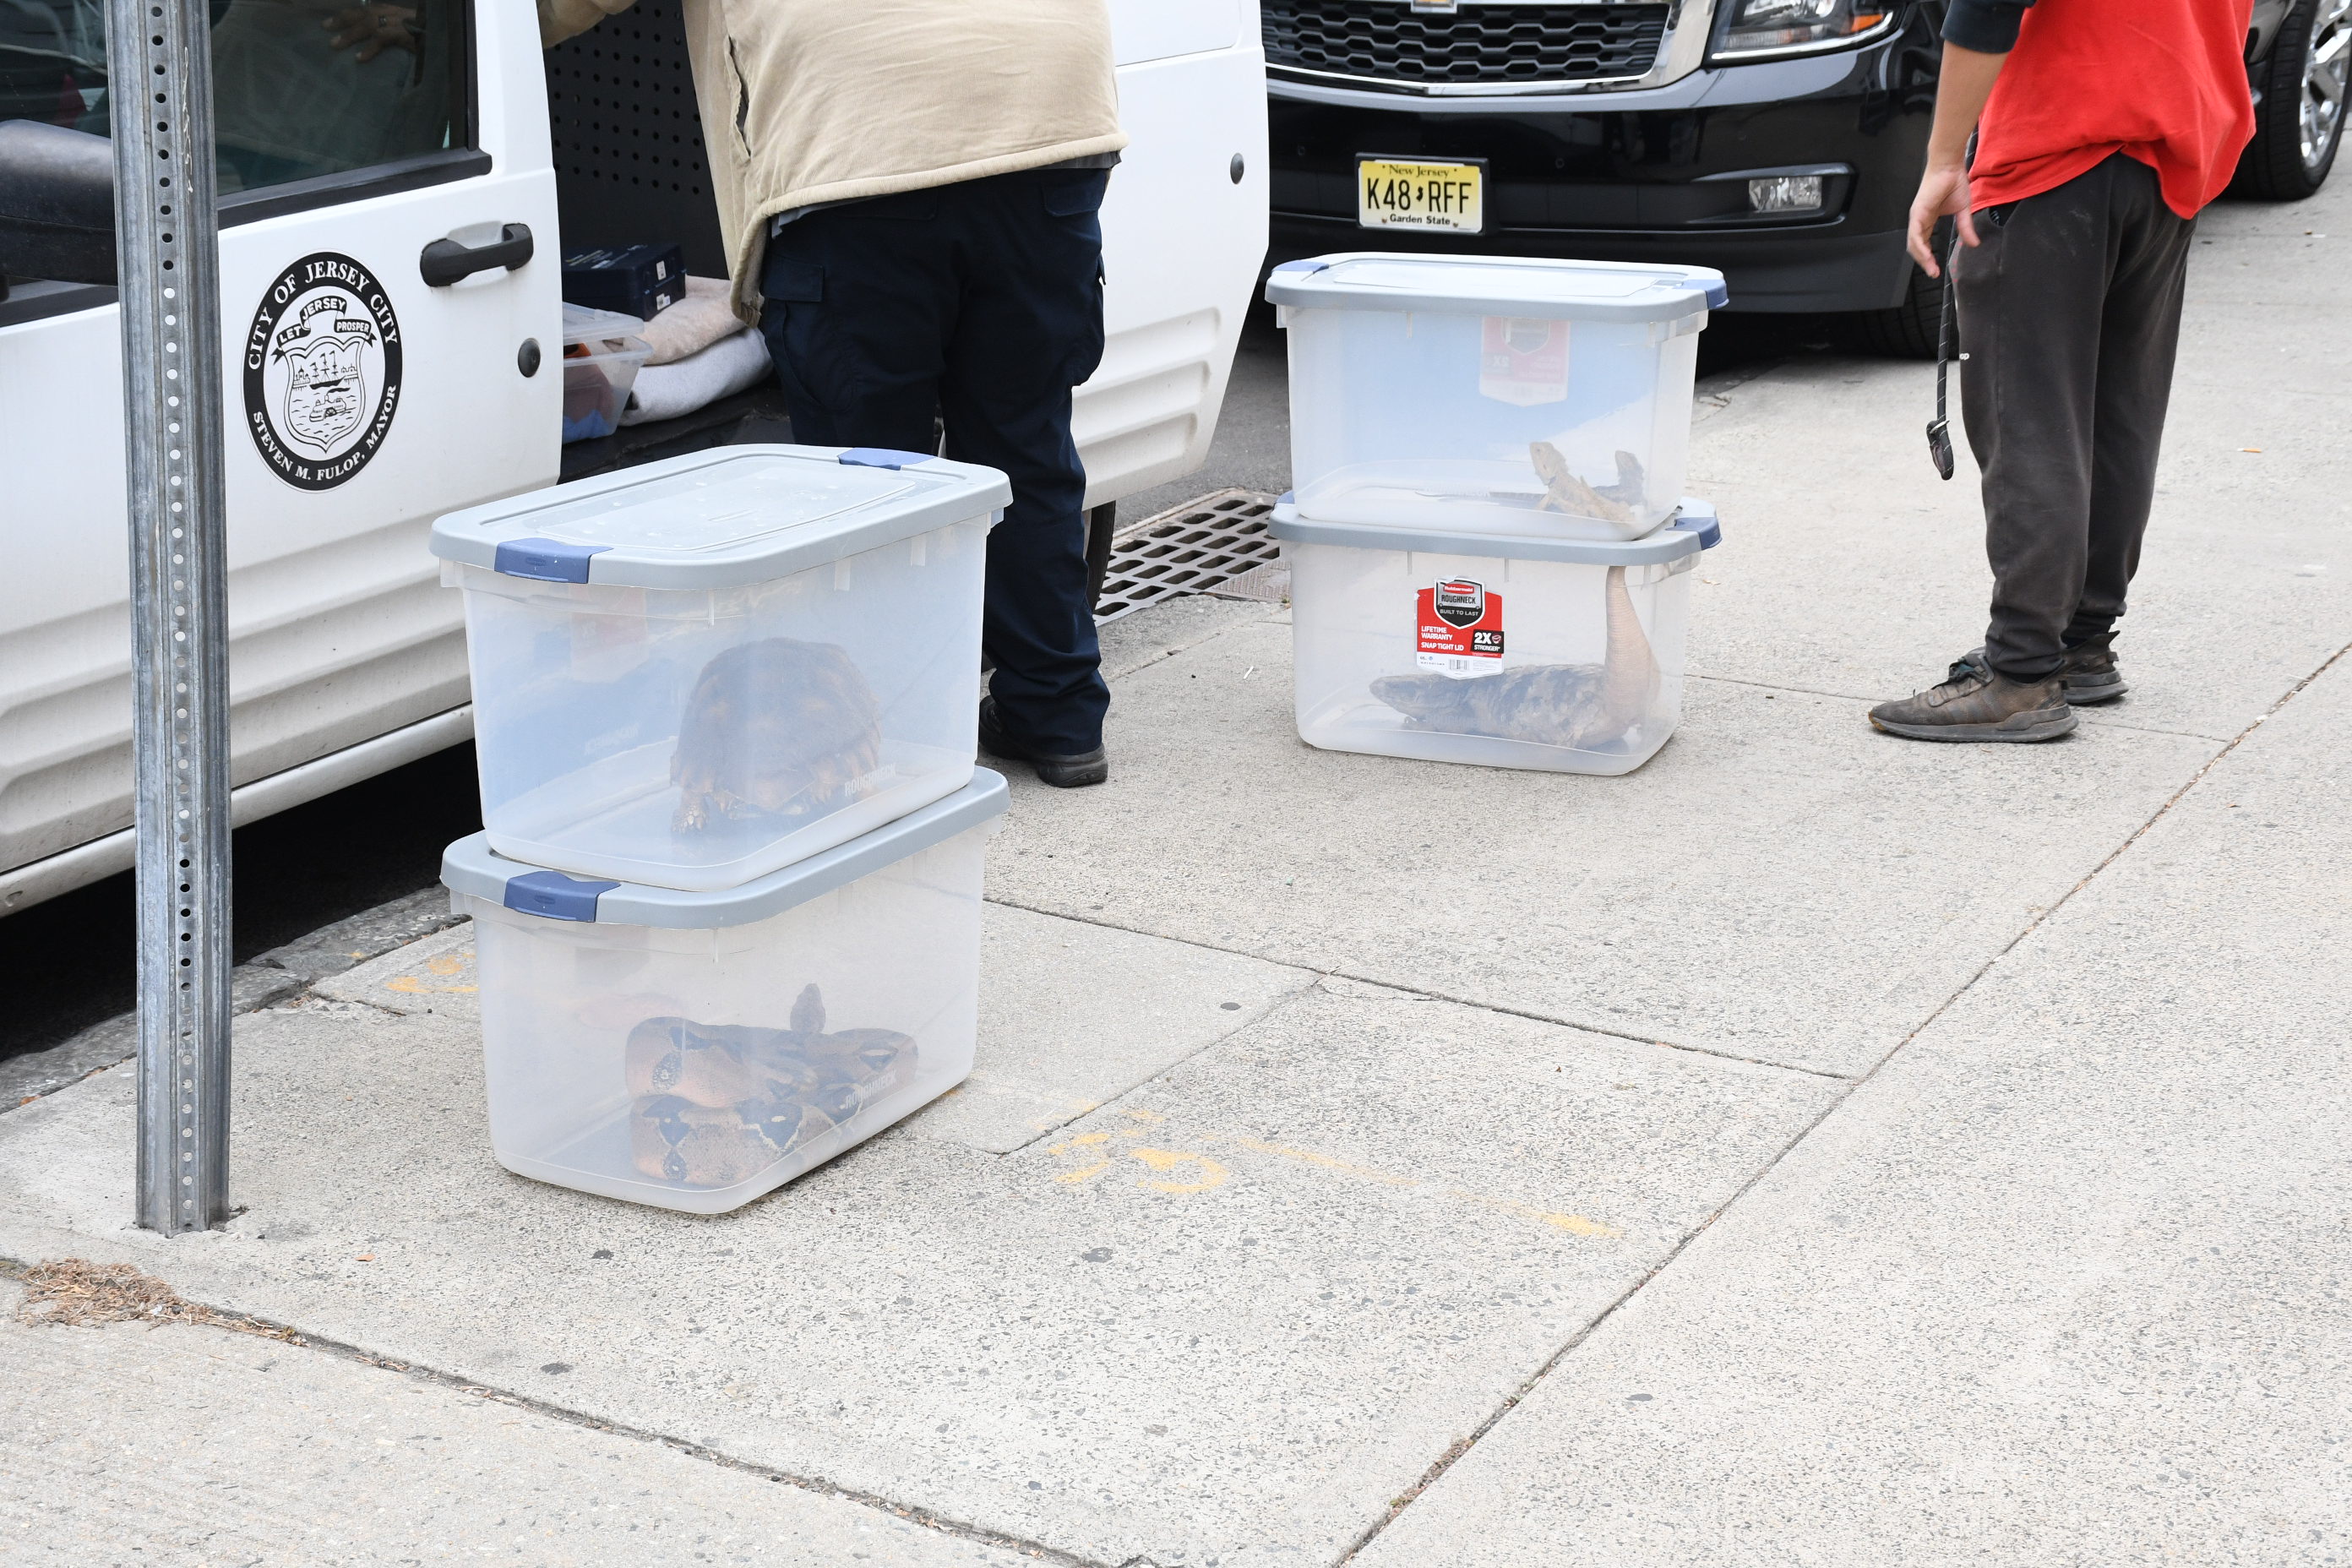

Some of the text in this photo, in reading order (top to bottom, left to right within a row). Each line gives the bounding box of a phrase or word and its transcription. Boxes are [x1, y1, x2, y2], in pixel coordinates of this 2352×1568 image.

[1389, 164, 1450, 178] New Jersey
[1367, 177, 1472, 214] K48 RFF
[1390, 213, 1451, 226] Garden State
[248, 259, 398, 370] CITY OF JERSEY CITY
[279, 299, 370, 343] LET JERSEY PROSPER
[253, 384, 397, 482] STEVEN M. FULOP, MAYOR
[1441, 594, 1476, 604] ROUGHNECK
[1421, 625, 1447, 634] LIFETIME
[1421, 632, 1453, 640] WARRANTY
[1474, 632, 1492, 645] 2X
[1437, 642, 1454, 651] TIGHT
